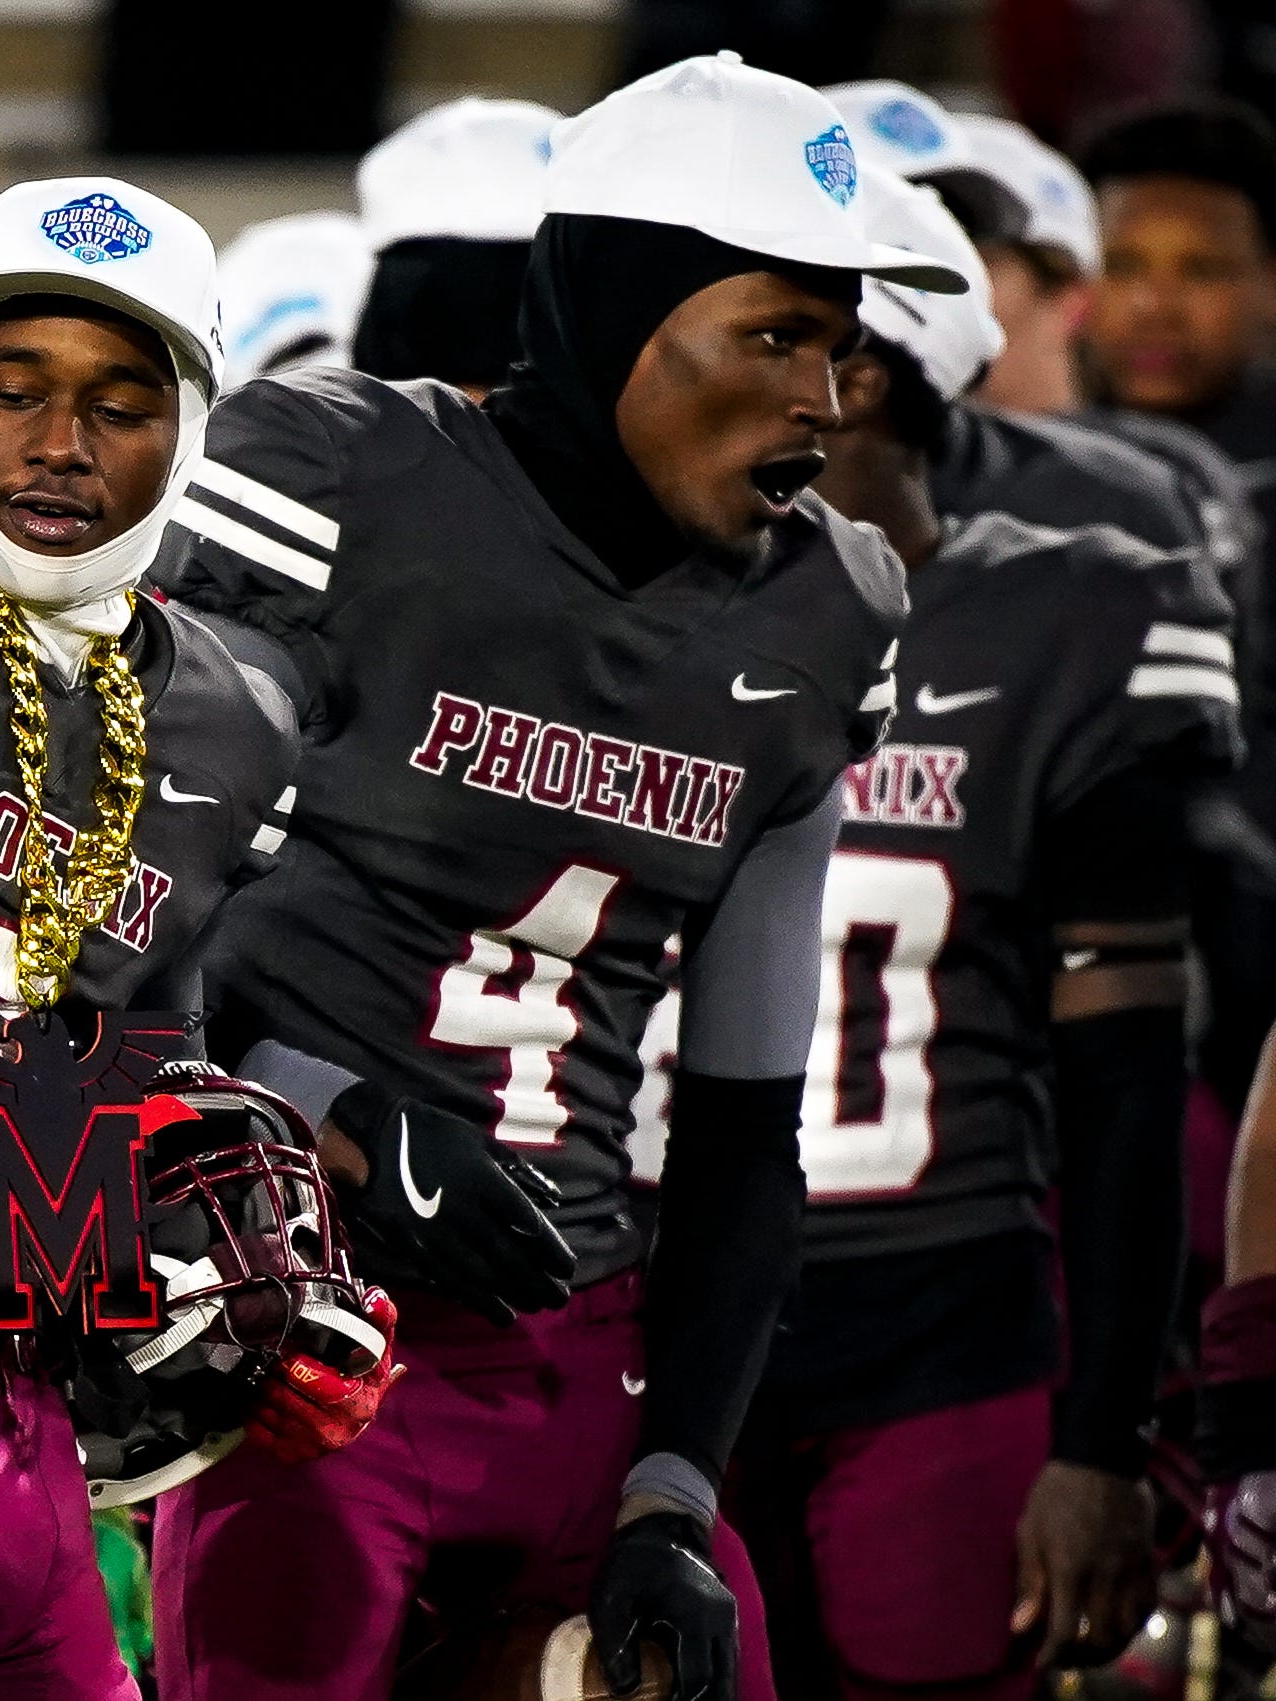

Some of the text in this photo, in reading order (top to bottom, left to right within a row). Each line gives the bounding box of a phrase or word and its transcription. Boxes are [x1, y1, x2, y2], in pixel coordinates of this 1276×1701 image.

[44, 207, 148, 246] BLUECROSS
[69, 222, 121, 241] BOWL
[409, 691, 746, 848] PHOENIX
[427, 862, 622, 1148] 4
